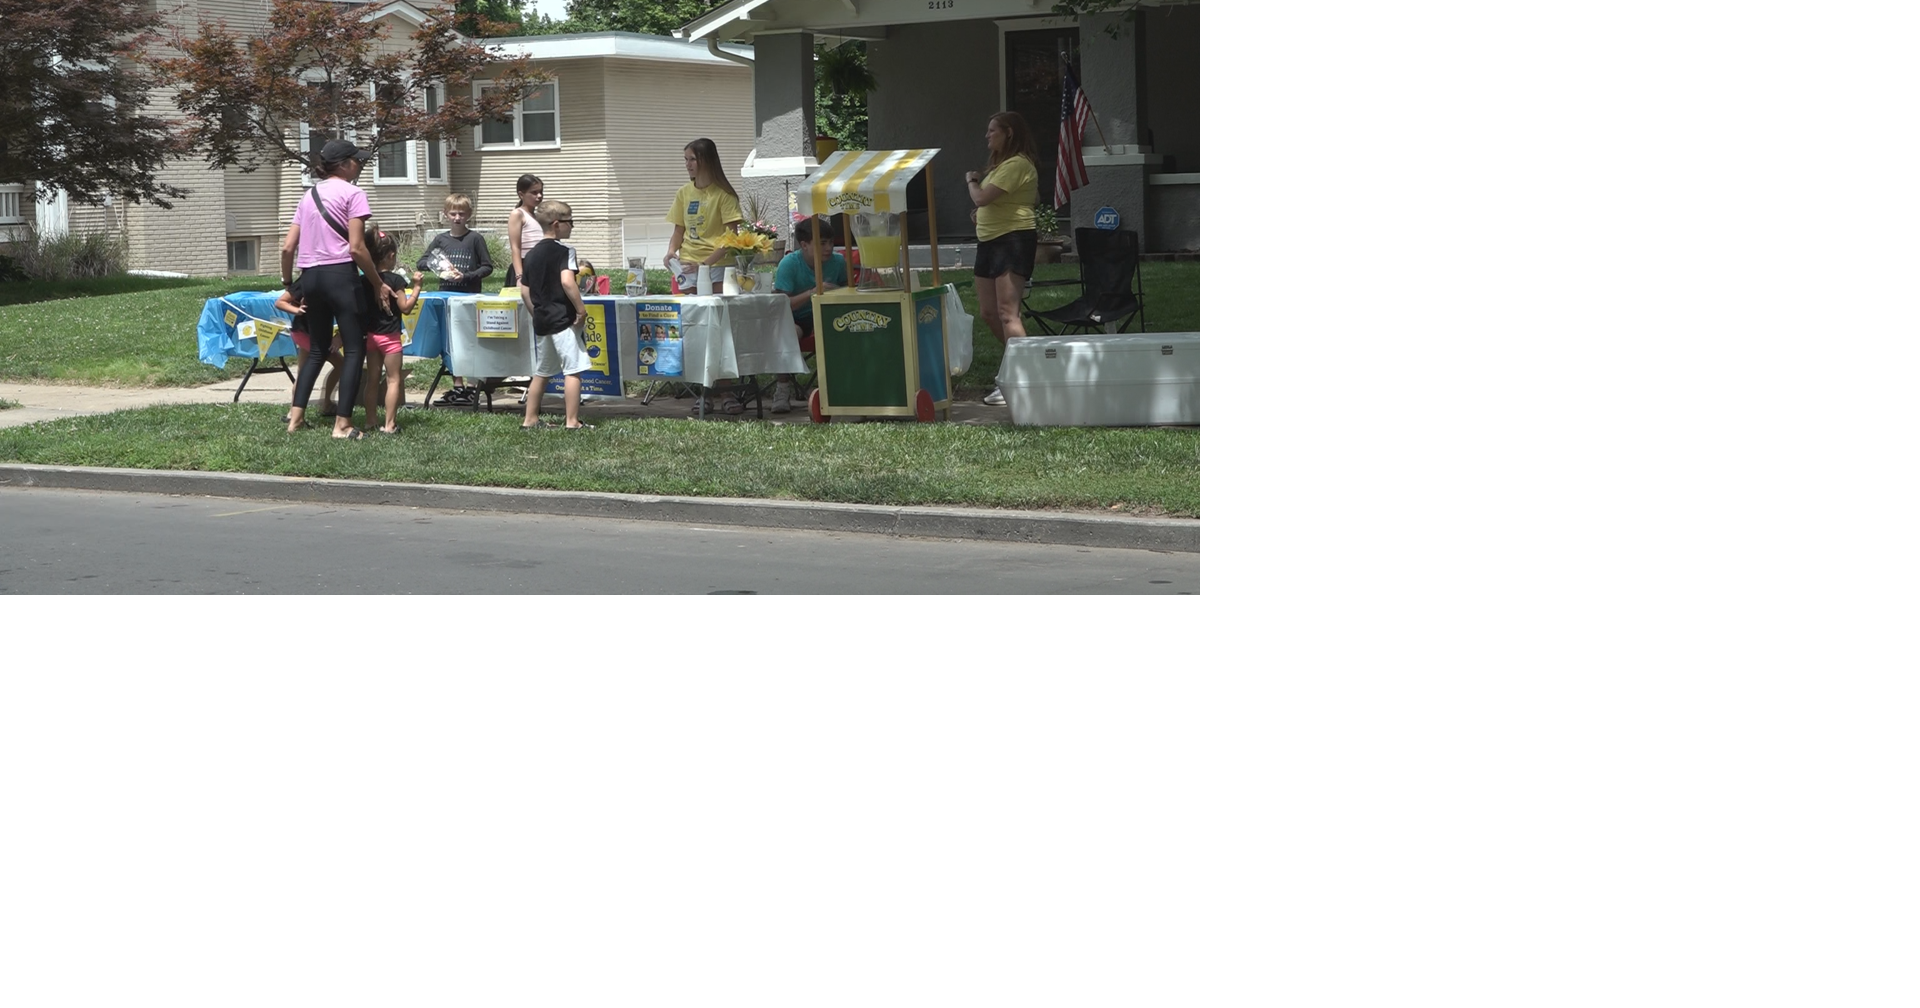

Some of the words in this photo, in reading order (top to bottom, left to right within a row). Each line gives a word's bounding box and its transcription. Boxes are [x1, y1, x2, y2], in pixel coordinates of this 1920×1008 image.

[928, 0, 954, 10] 2113
[827, 192, 874, 209] COUNTRY
[1096, 214, 1118, 225] ADT
[833, 310, 891, 332] COUNTRY
[848, 322, 875, 332] TIME
